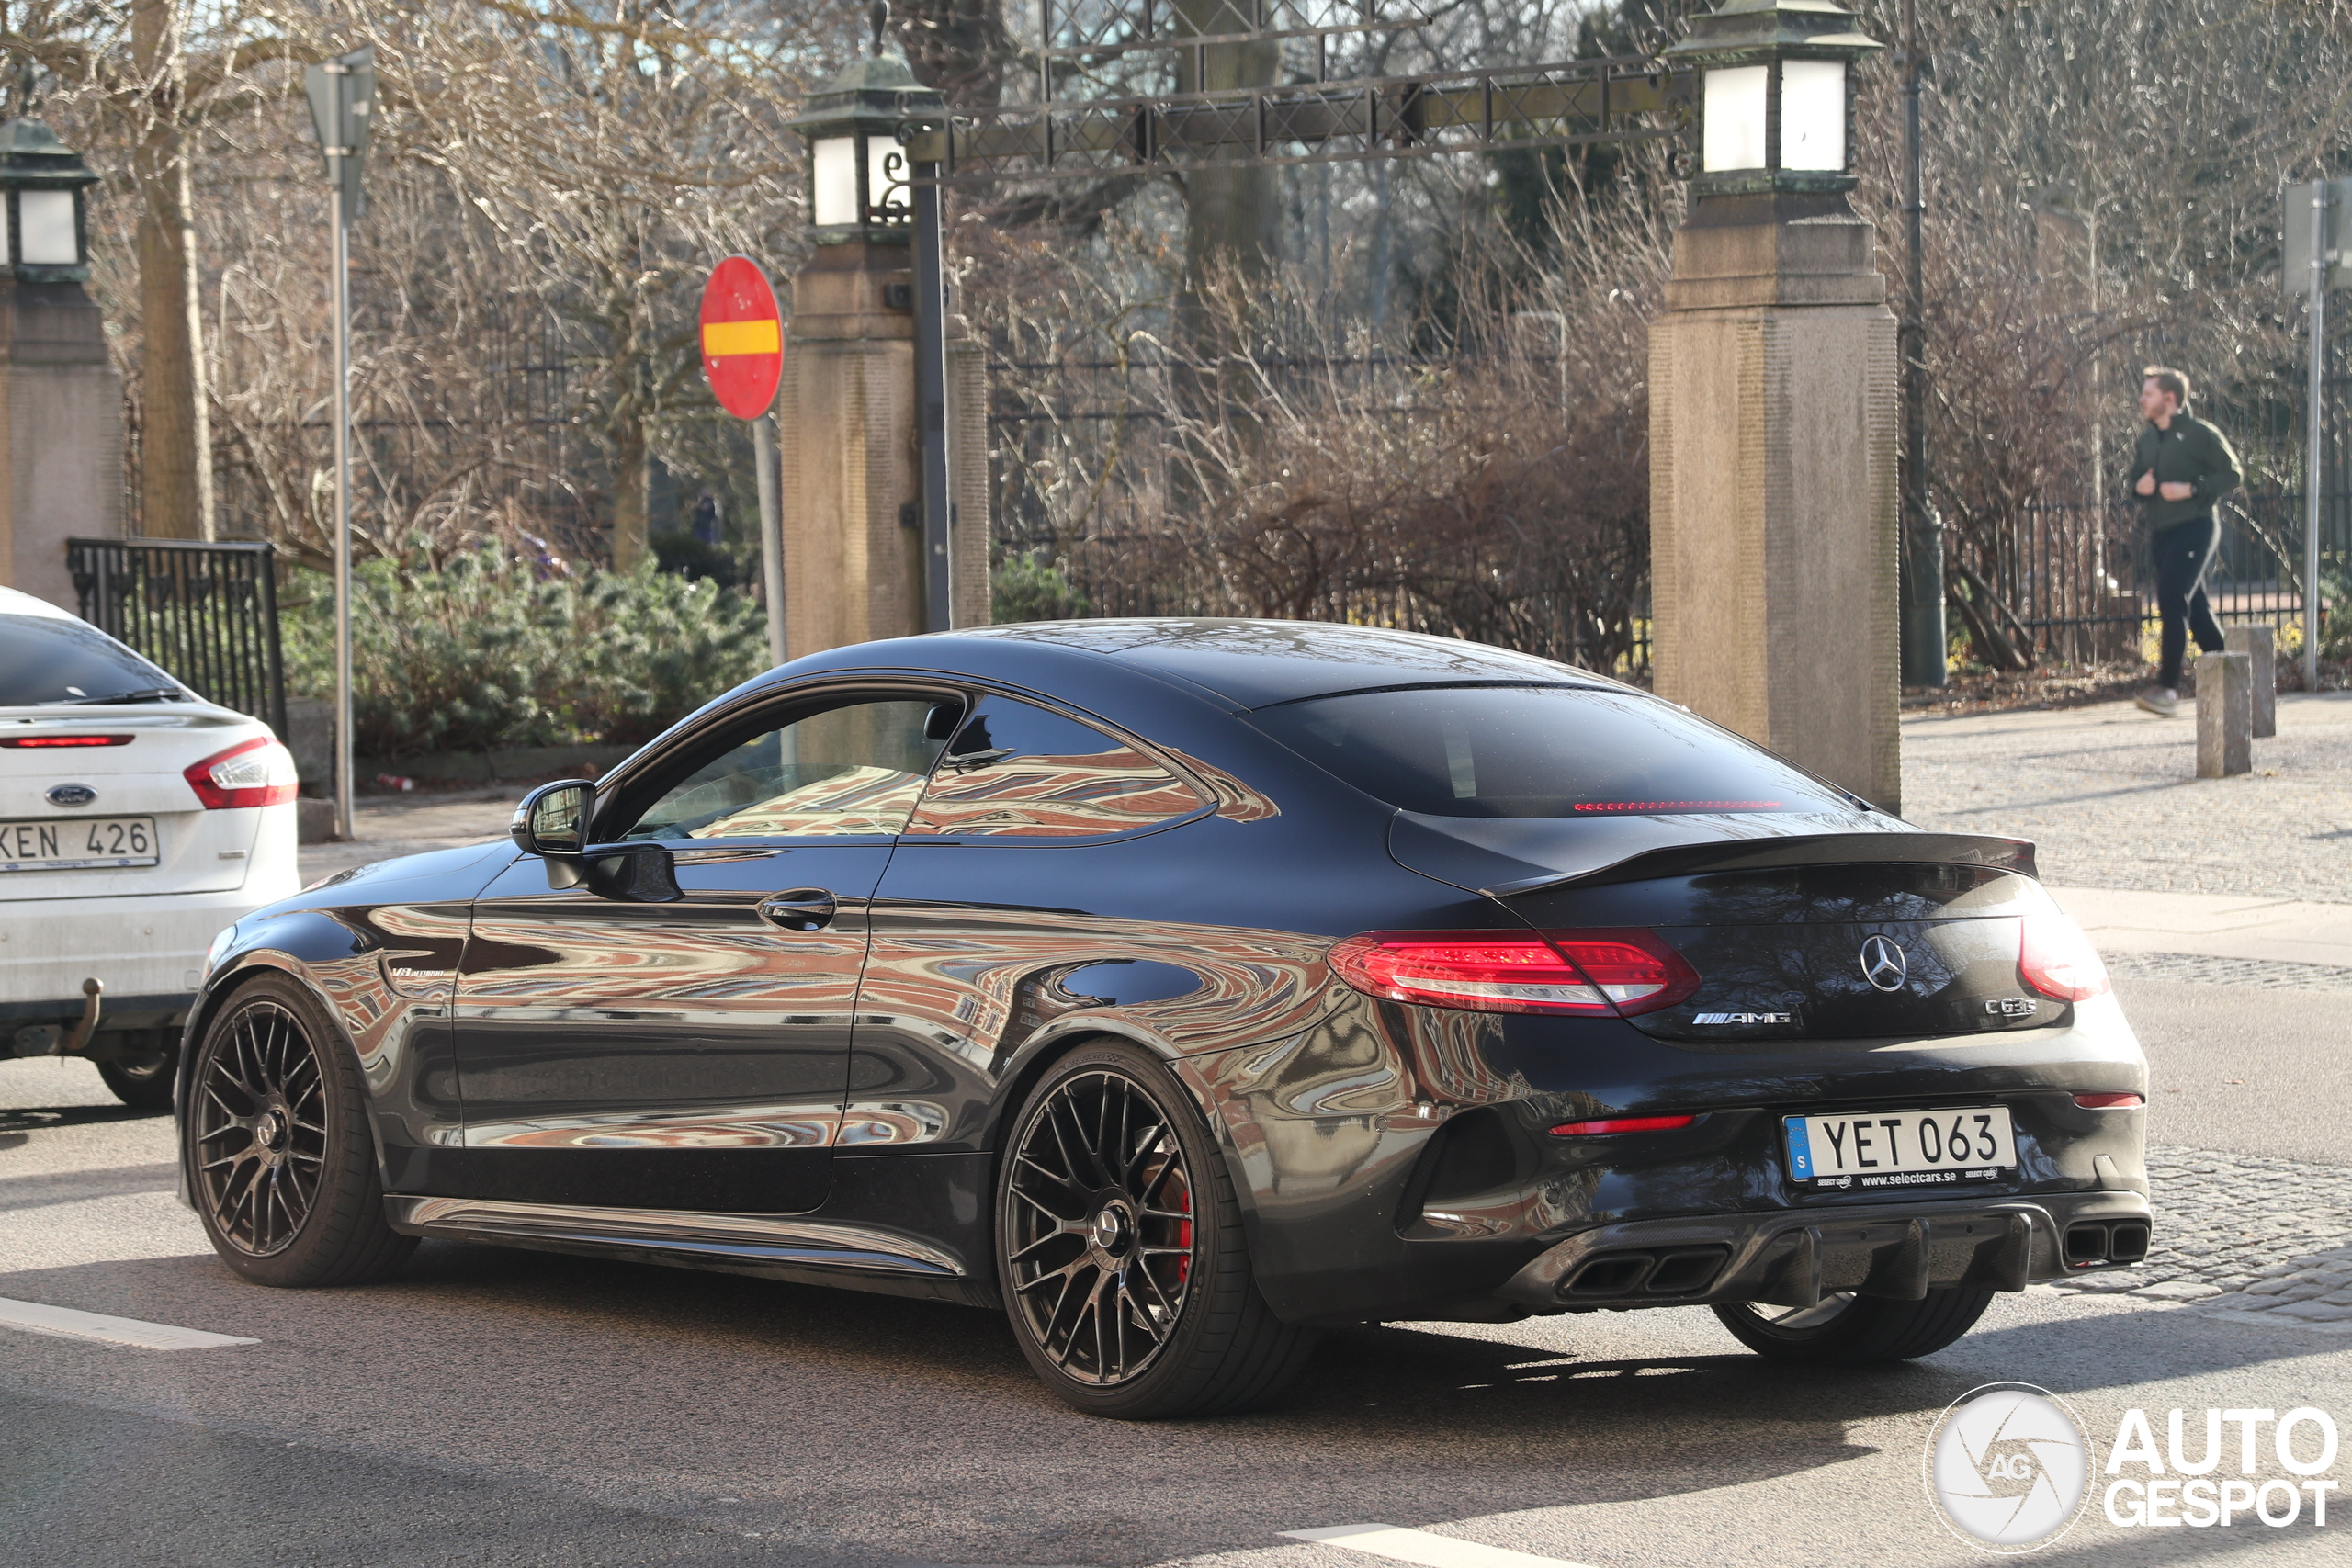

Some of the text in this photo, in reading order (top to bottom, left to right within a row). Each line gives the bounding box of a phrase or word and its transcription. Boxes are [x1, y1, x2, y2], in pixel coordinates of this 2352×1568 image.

[0, 823, 148, 858] KEN 426
[392, 967, 412, 976] V8
[1724, 1012, 1791, 1024] AMG
[1823, 1114, 1996, 1169] YET 063
[1797, 1155, 1806, 1168] S
[1861, 1170, 1957, 1187] www.selectcars.se
[1965, 1170, 1983, 1179] SELECT
[1817, 1179, 1836, 1187] SELECT
